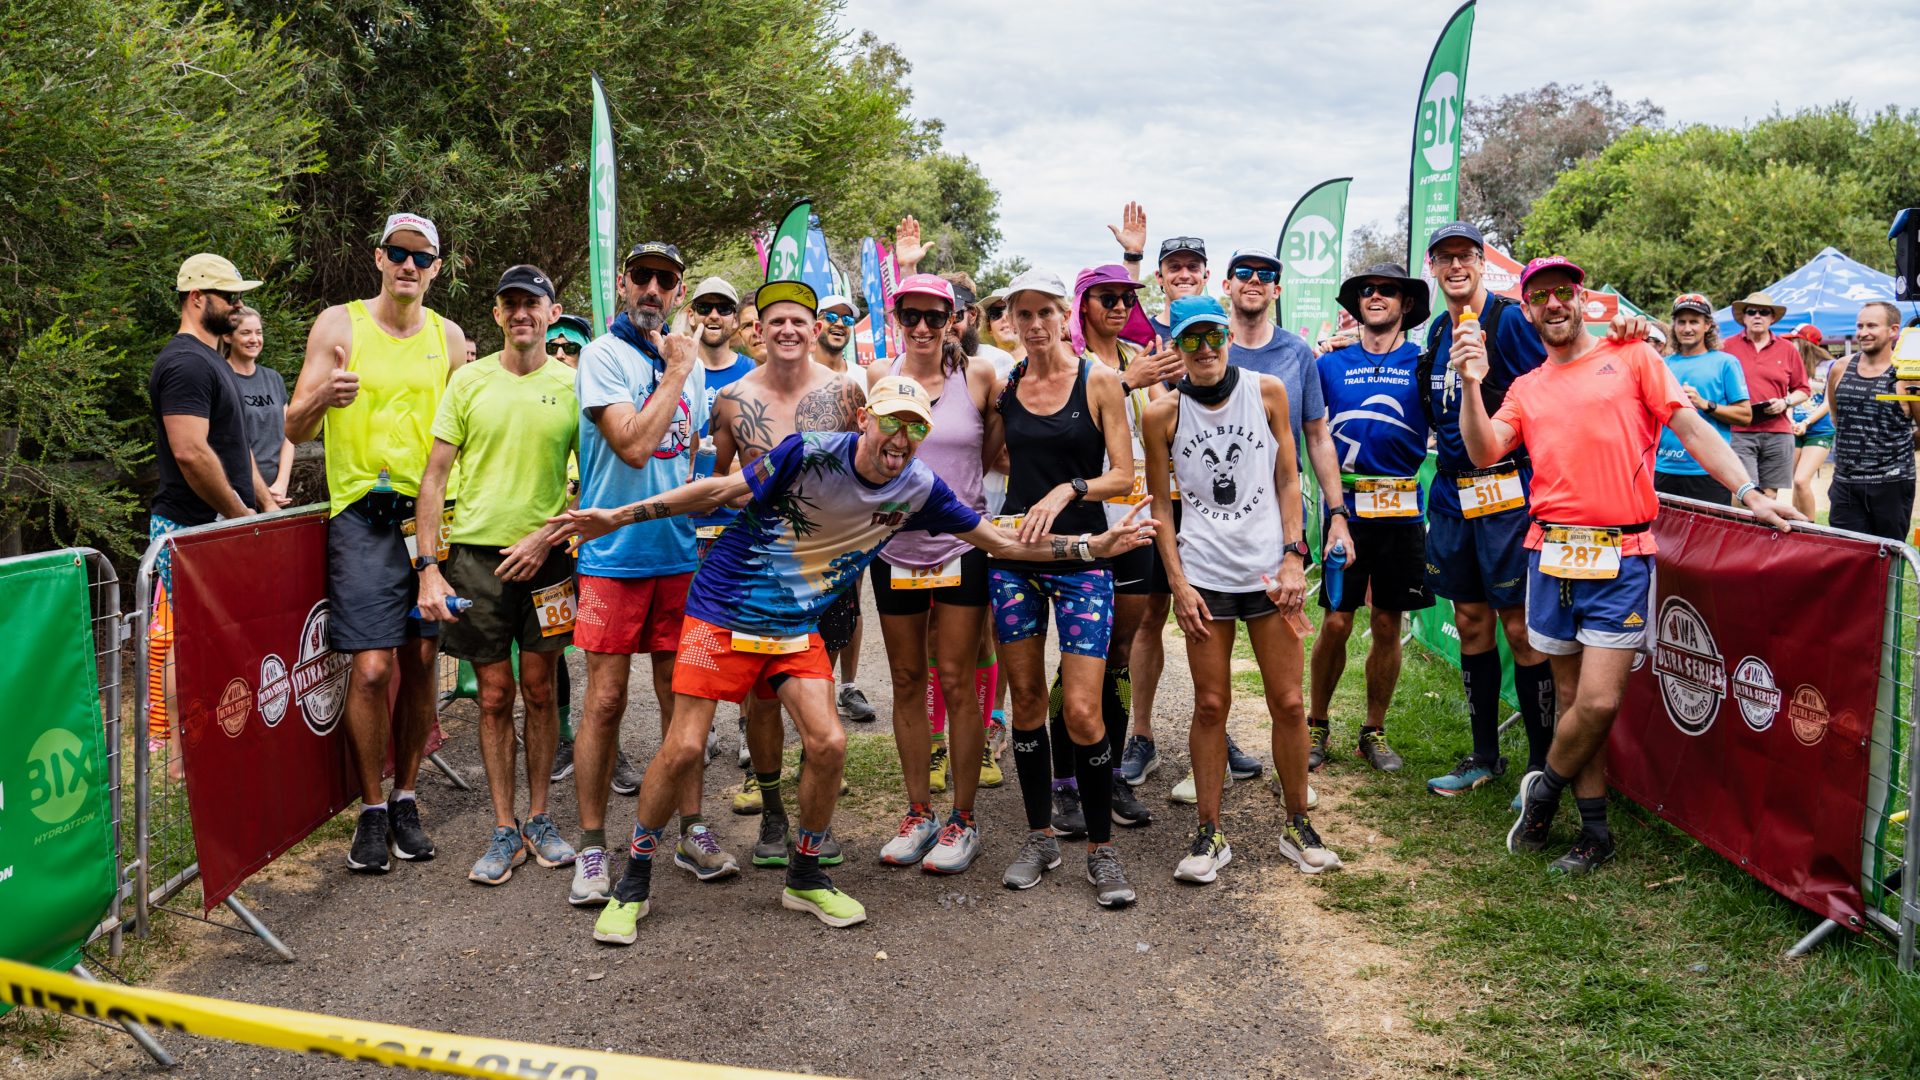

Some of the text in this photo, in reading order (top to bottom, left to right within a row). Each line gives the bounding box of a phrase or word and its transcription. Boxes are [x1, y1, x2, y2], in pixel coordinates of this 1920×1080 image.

[1433, 192, 1443, 201] 12
[1287, 230, 1340, 261] BIX
[1344, 376, 1410, 386] TRAIL RUNNERS
[1345, 366, 1410, 376] MANNIG PARK
[1187, 487, 1264, 521] ENDURANCE
[1371, 492, 1401, 509] 154
[1475, 482, 1503, 505] 511
[1559, 545, 1602, 567] 287
[546, 599, 572, 625] 86
[1677, 615, 1698, 648] WA
[295, 664, 323, 693] ULTRA
[1658, 647, 1722, 687] ULTRA SERIES
[1752, 666, 1764, 685] WA
[1736, 683, 1778, 706] ULTRA SERIES
[26, 743, 92, 810] BIX
[34, 811, 96, 846] HYDRATION
